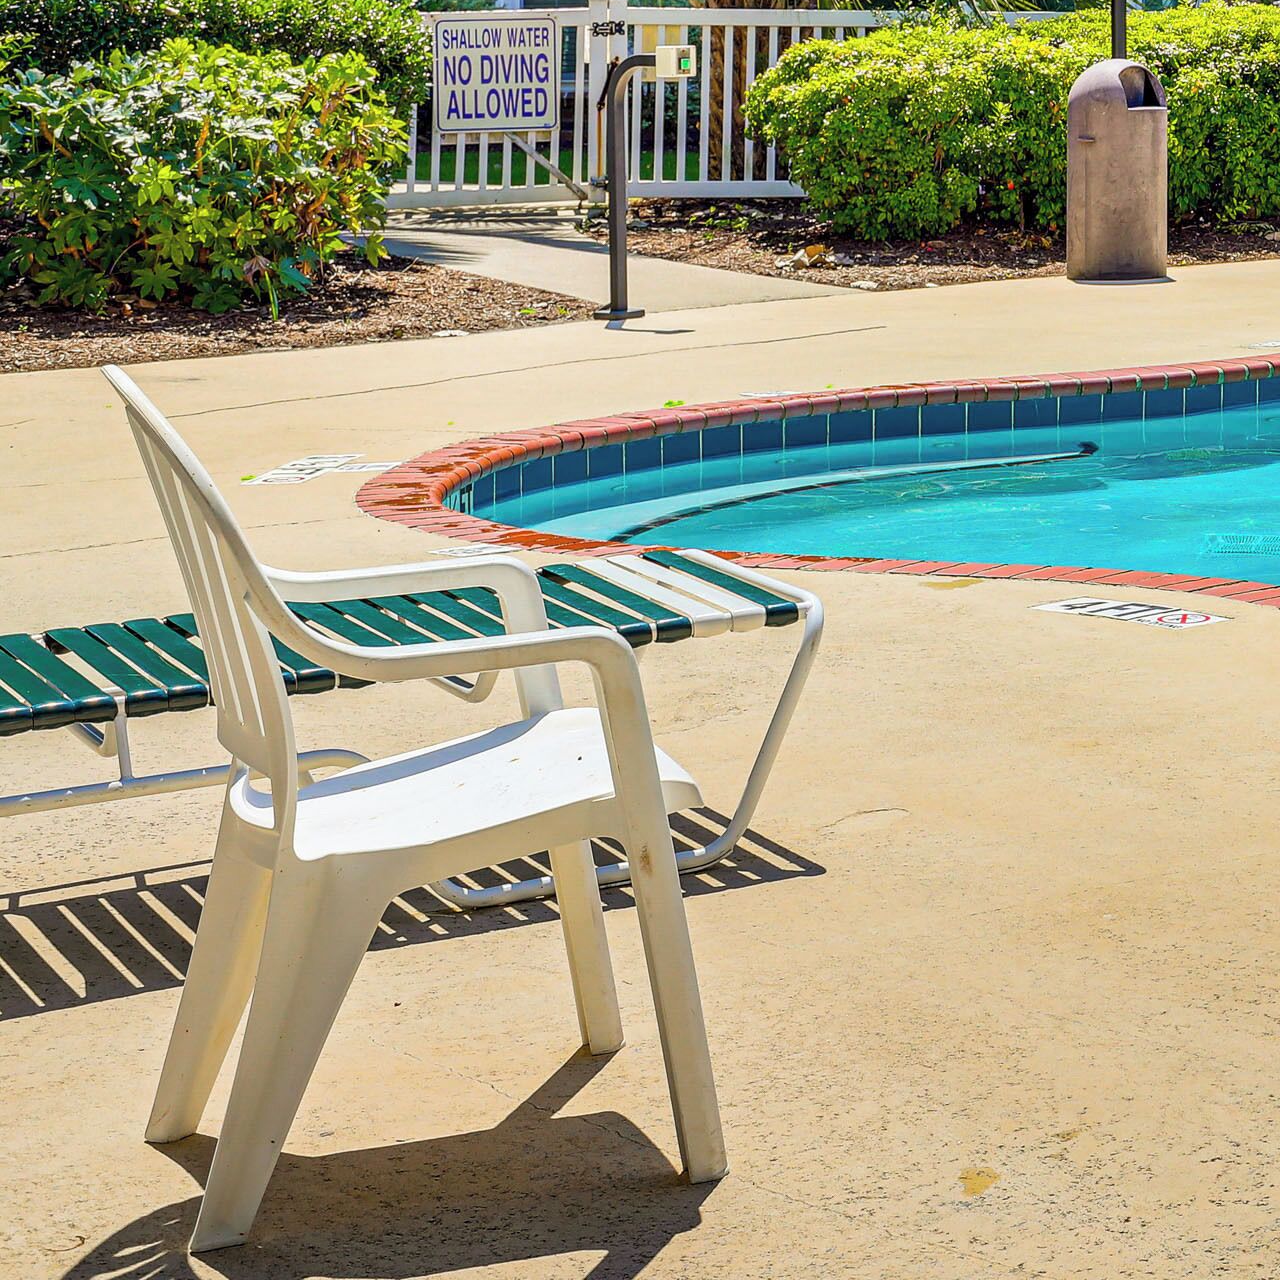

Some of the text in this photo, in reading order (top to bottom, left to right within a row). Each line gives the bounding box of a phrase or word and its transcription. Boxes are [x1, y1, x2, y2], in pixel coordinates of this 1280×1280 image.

[442, 27, 549, 49] SHALLOW WATER
[444, 53, 549, 85] NO DIVING
[447, 88, 548, 120] ALLOWED
[1086, 602, 1173, 618] FT
